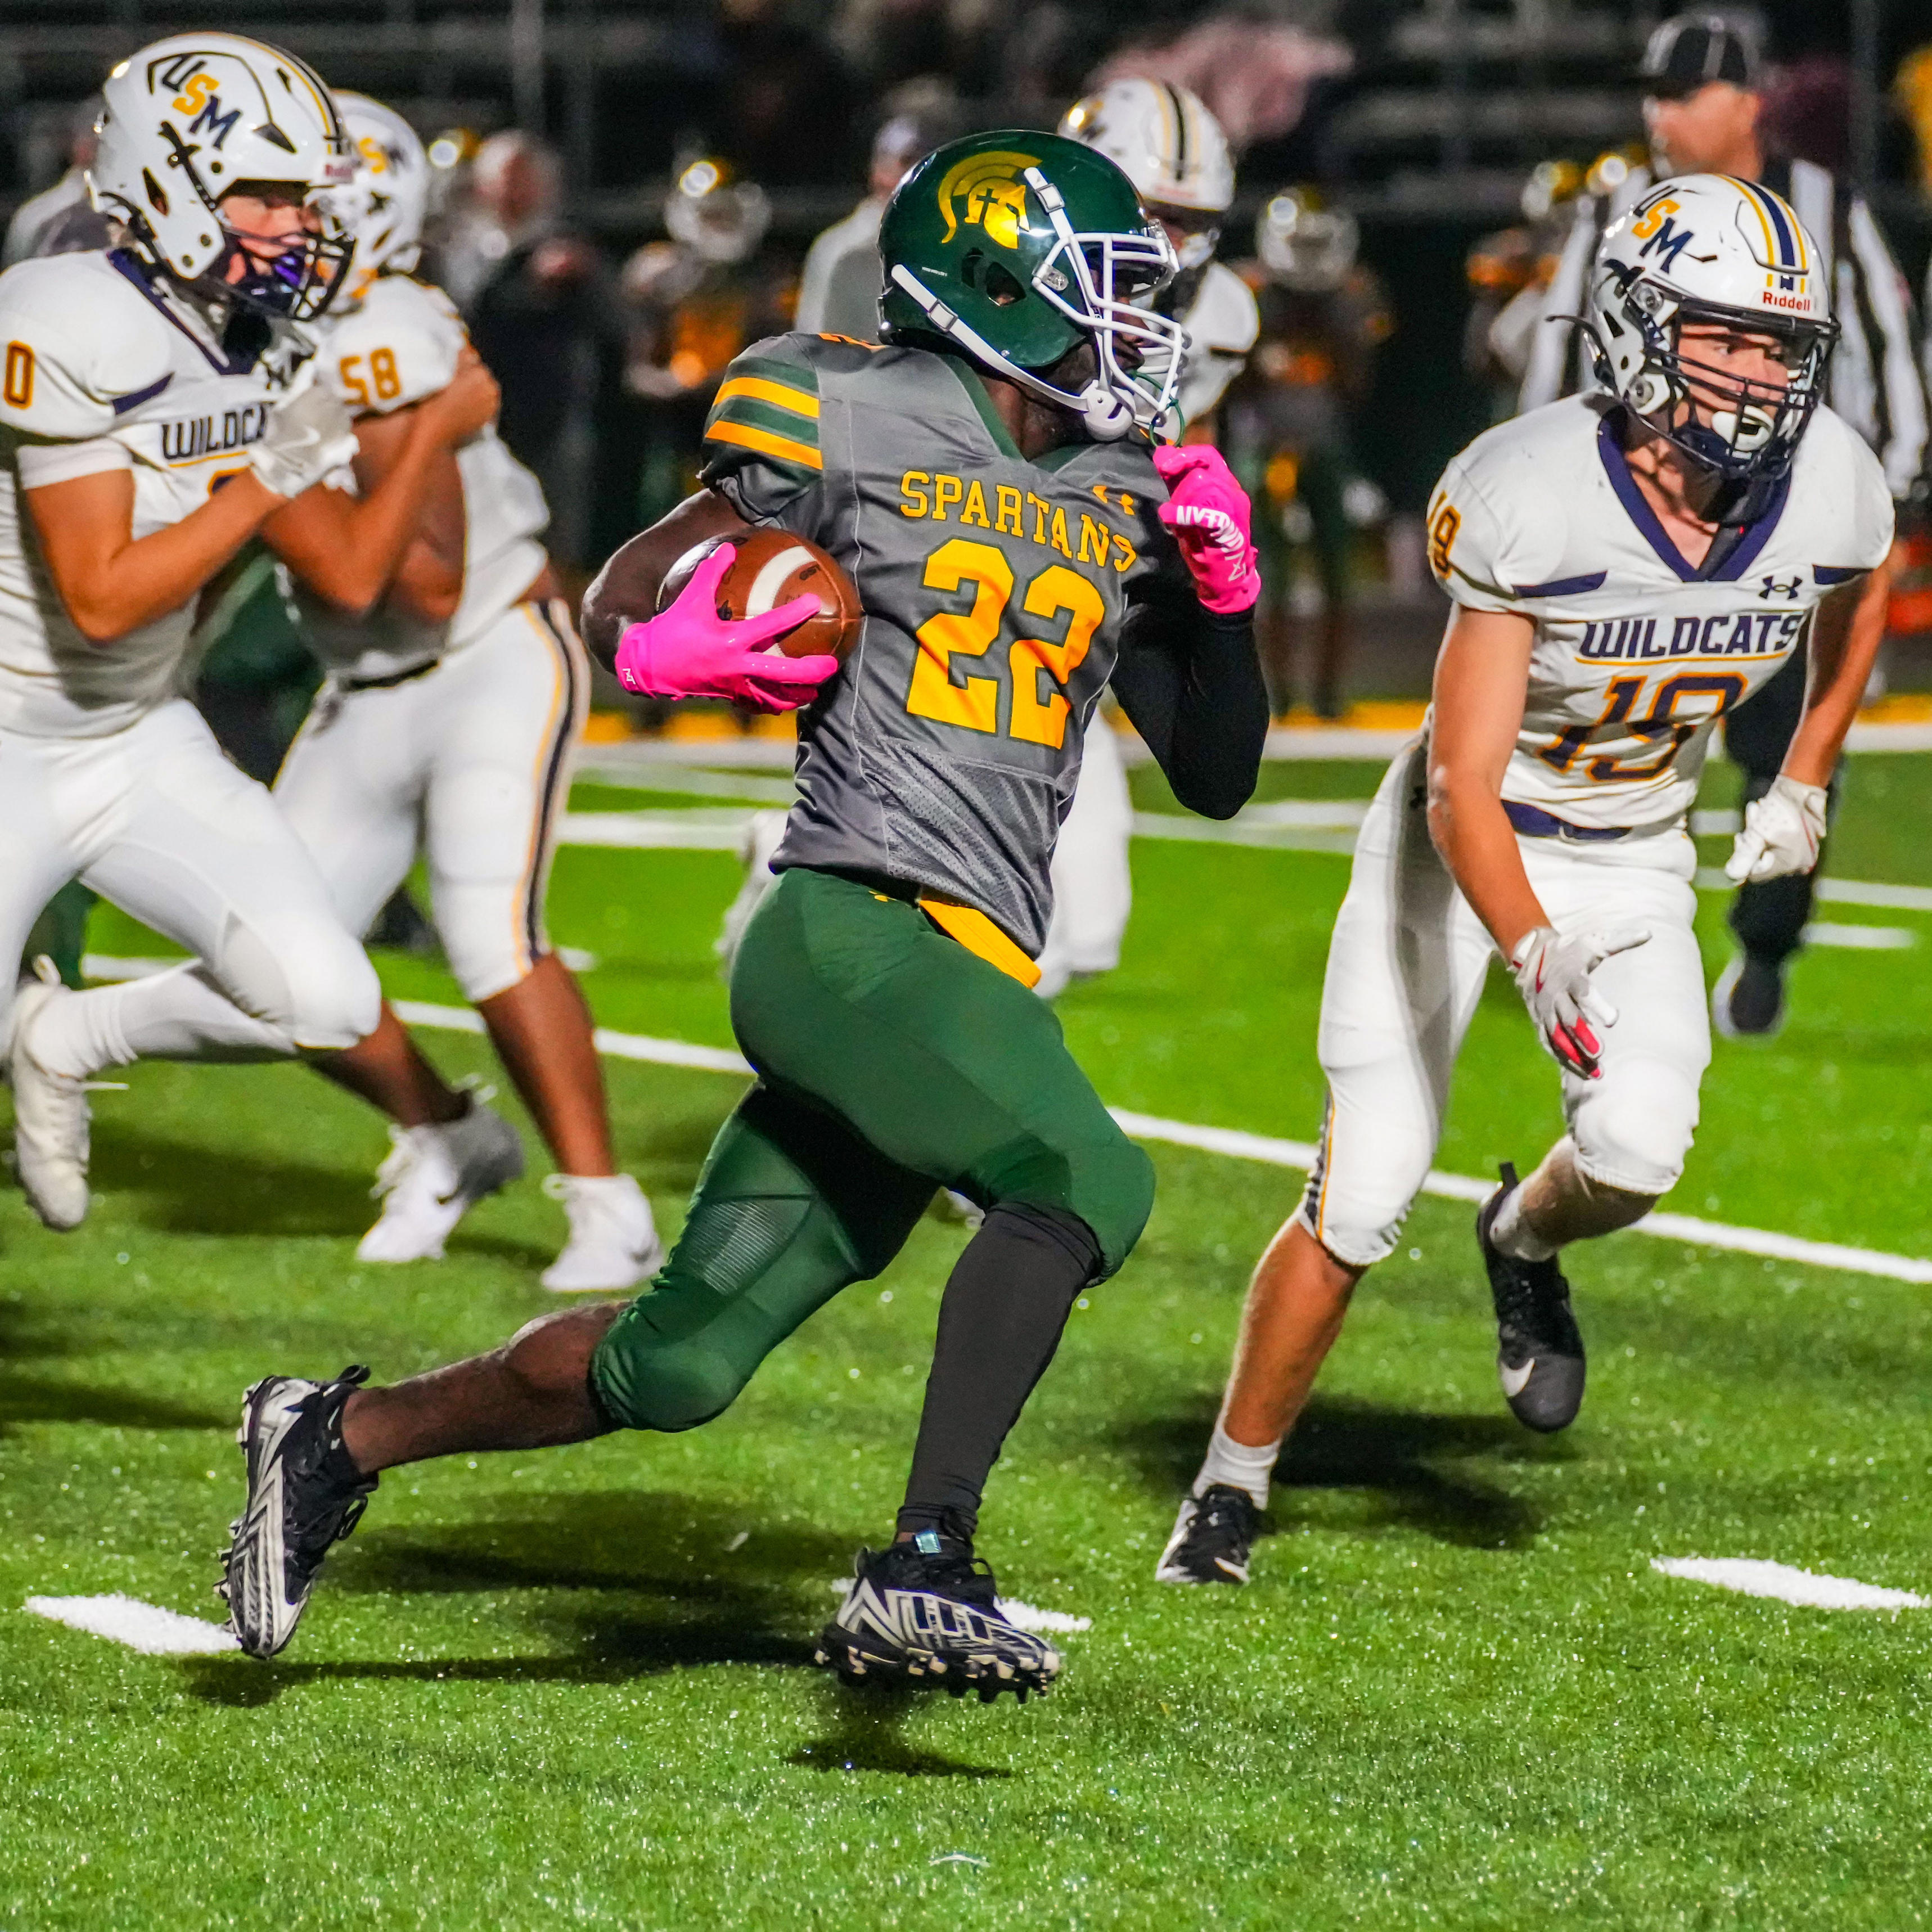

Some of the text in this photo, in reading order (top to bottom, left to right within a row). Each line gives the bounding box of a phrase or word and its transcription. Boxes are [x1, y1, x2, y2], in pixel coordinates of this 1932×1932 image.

[1763, 291, 1811, 312] Riddell
[339, 347, 401, 406] 58
[900, 470, 1137, 572] SPARTANS
[906, 538, 1105, 750] 22
[1579, 614, 1804, 658] WILDCATS
[1537, 672, 1748, 782] 19
